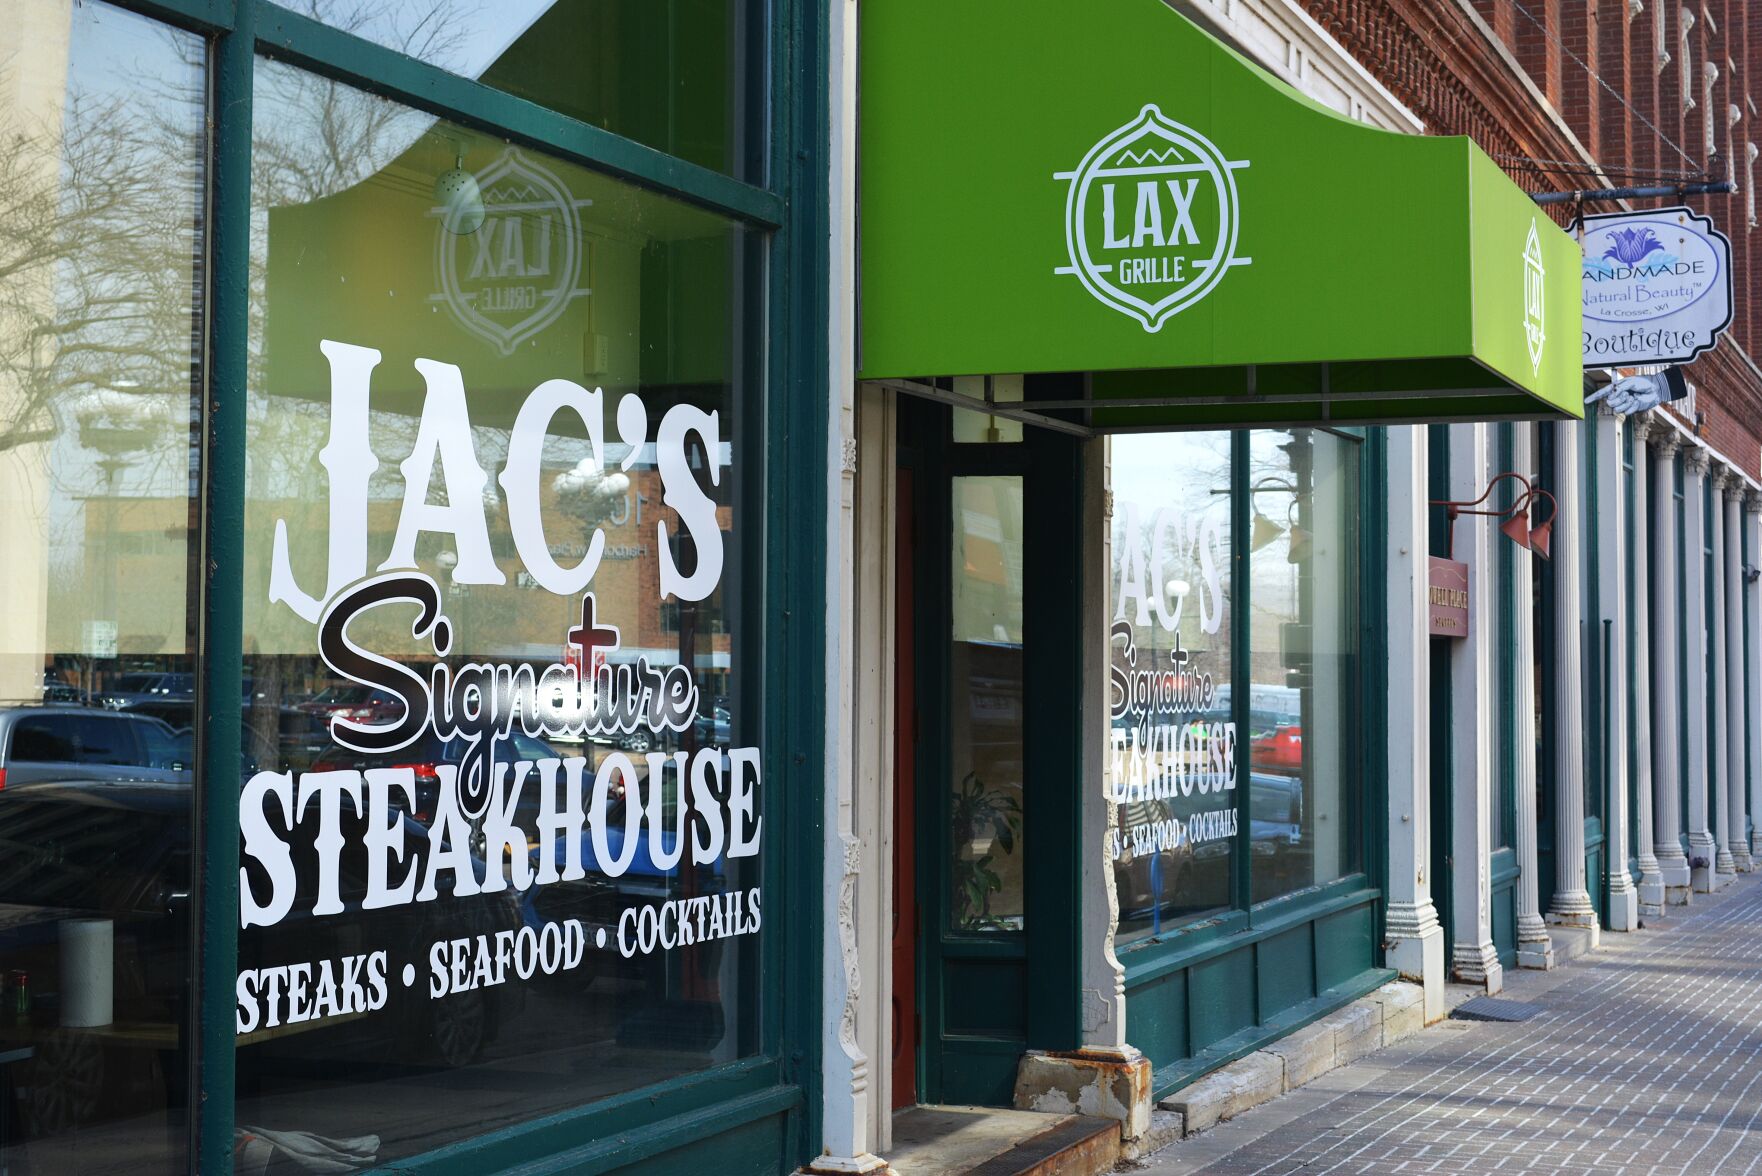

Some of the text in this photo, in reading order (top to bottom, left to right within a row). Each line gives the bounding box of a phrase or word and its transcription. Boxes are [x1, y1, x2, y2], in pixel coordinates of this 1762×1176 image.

[1102, 178, 1200, 249] LAX
[1119, 256, 1185, 284] GRILLE
[1582, 261, 1705, 282] ANDMADE
[1600, 308, 1611, 316] La
[1654, 303, 1669, 311] WI
[269, 339, 723, 624] JAC'S
[1113, 501, 1223, 635] AC'S
[318, 571, 698, 818] Signature
[1111, 621, 1216, 759] Signature
[1111, 721, 1237, 805] EAKHOUSE
[239, 746, 762, 929] STEAKHOUSE
[1132, 818, 1180, 858] SEAFOOD
[1189, 808, 1238, 844] COCKTAILS
[236, 887, 762, 1034] STEAKS SEAFOOD COCKTAILS
